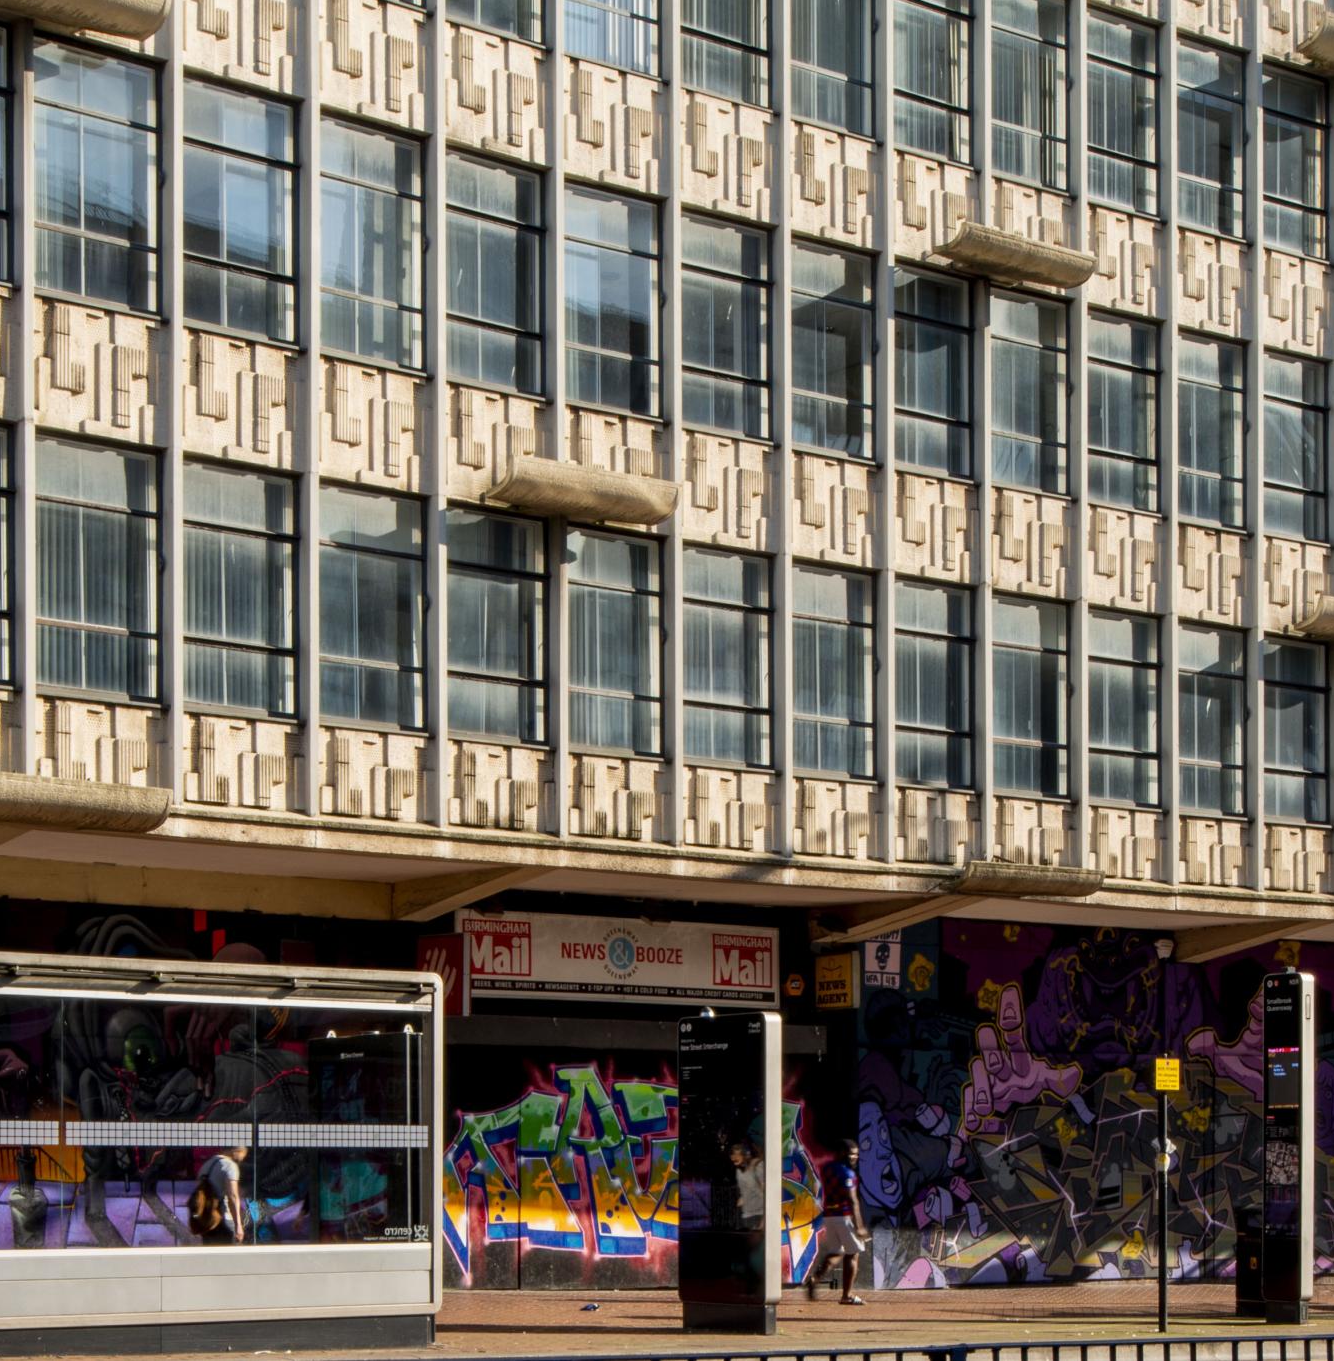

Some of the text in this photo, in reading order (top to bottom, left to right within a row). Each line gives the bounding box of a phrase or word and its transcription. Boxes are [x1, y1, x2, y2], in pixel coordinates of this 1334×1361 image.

[465, 920, 529, 935] BIRMINGHAM
[715, 935, 771, 949] BIRMINGHAM
[471, 934, 529, 975] Mail
[561, 940, 683, 965] NEWS & BOOZE
[715, 948, 771, 986] Mail
[819, 981, 846, 991] NEWS
[818, 993, 848, 1004] AGENT
